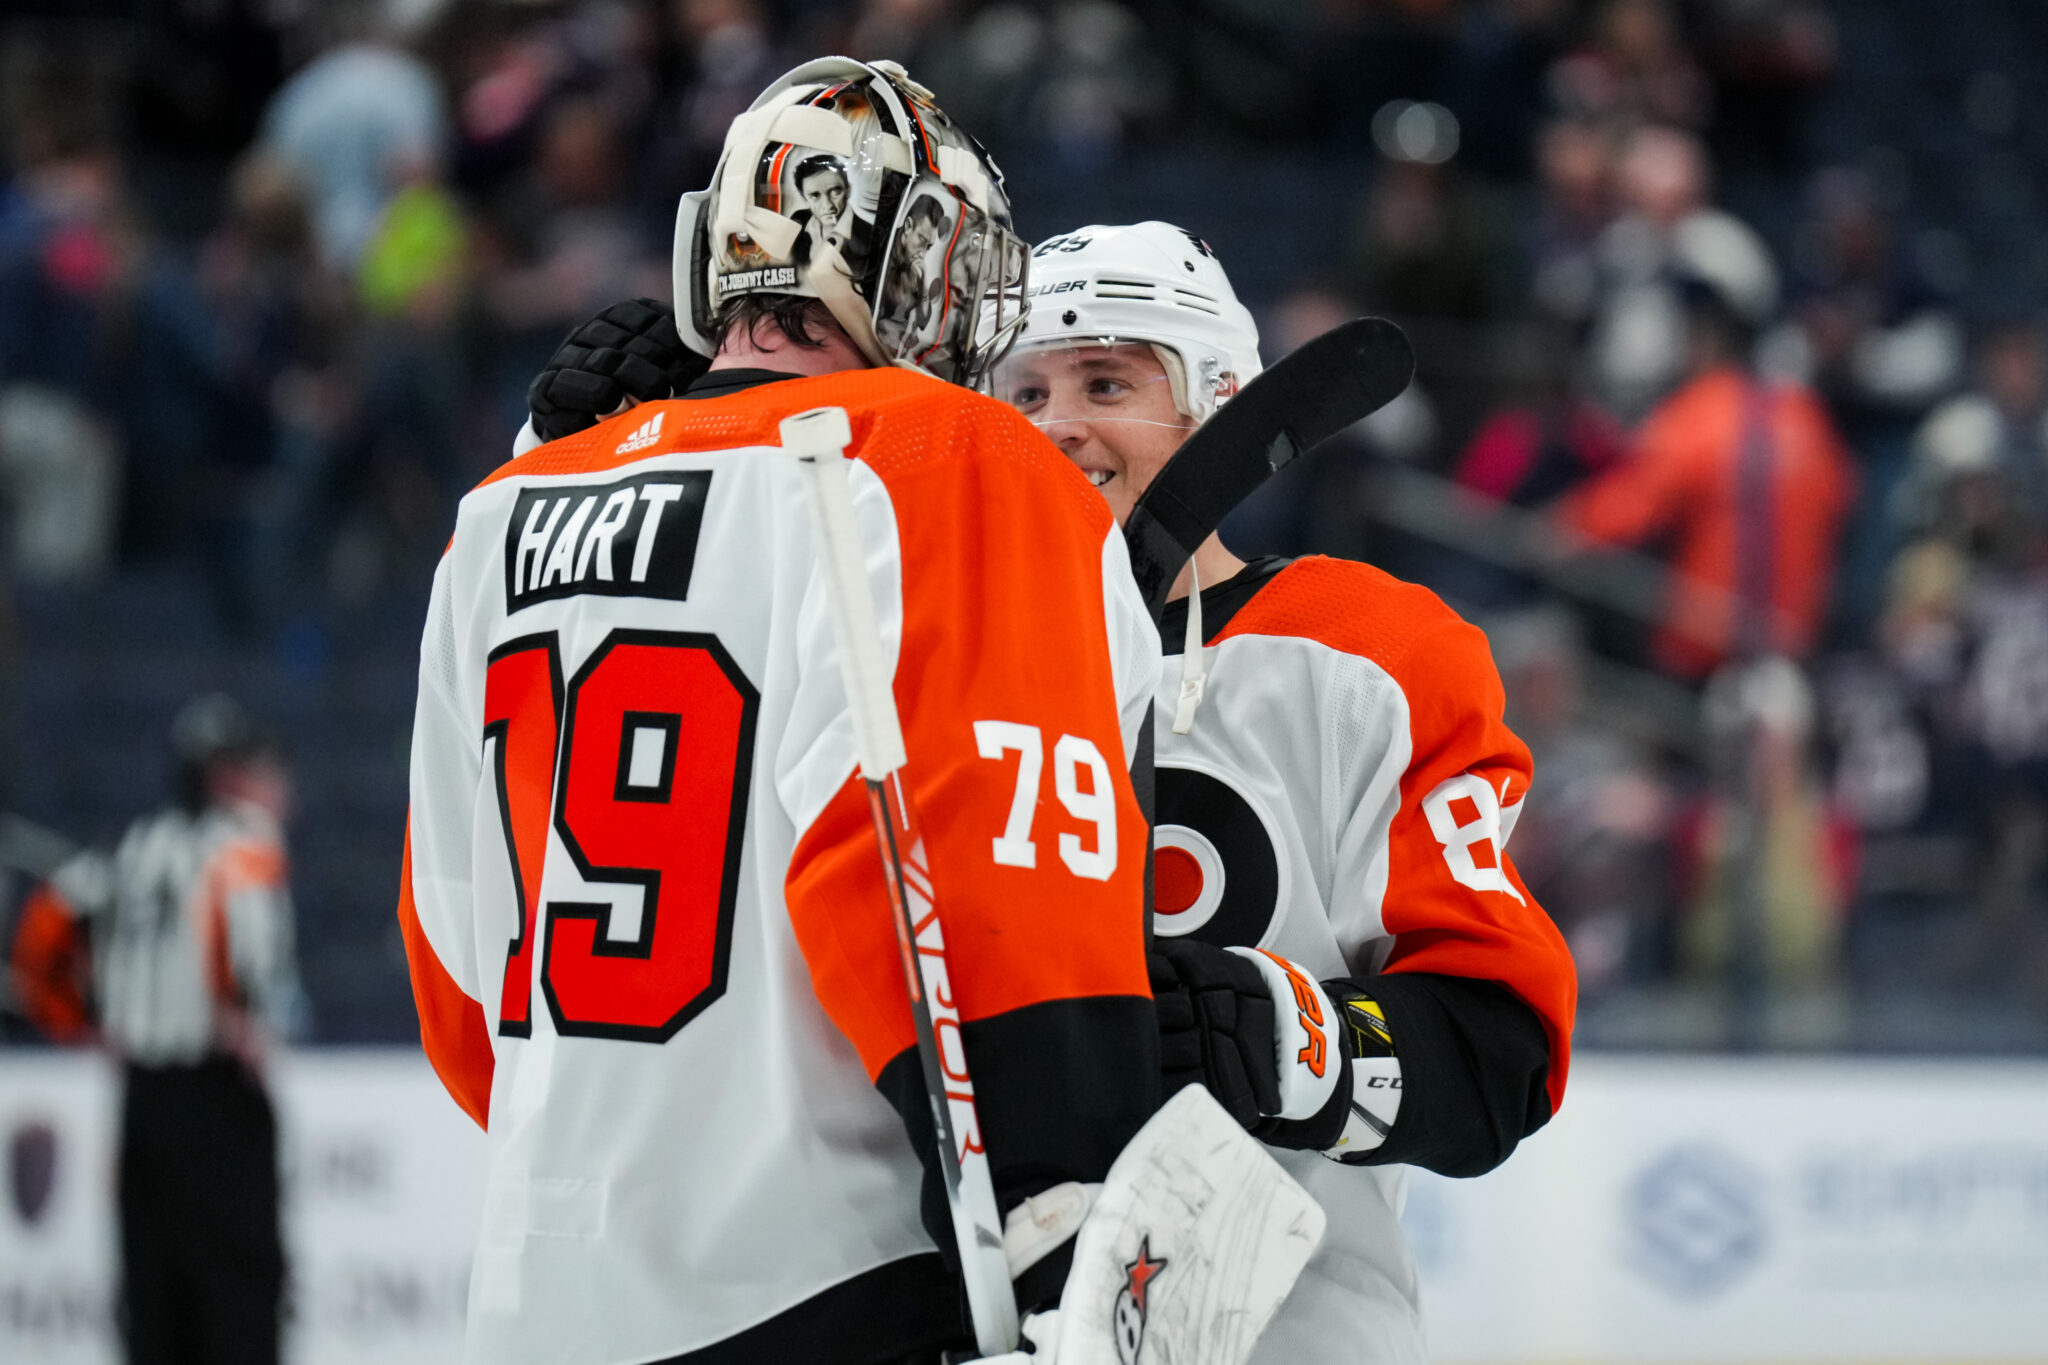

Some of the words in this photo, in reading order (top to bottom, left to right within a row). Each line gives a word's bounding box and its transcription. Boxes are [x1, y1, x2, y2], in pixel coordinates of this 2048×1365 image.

[728, 270, 763, 291] JOHNNY
[763, 267, 795, 287] CASH
[1026, 279, 1088, 298] AUER
[615, 434, 661, 455] adidas
[515, 483, 684, 596] HART
[973, 720, 1118, 882] 79
[482, 627, 761, 1044] 79
[1367, 1076, 1403, 1090] CC
